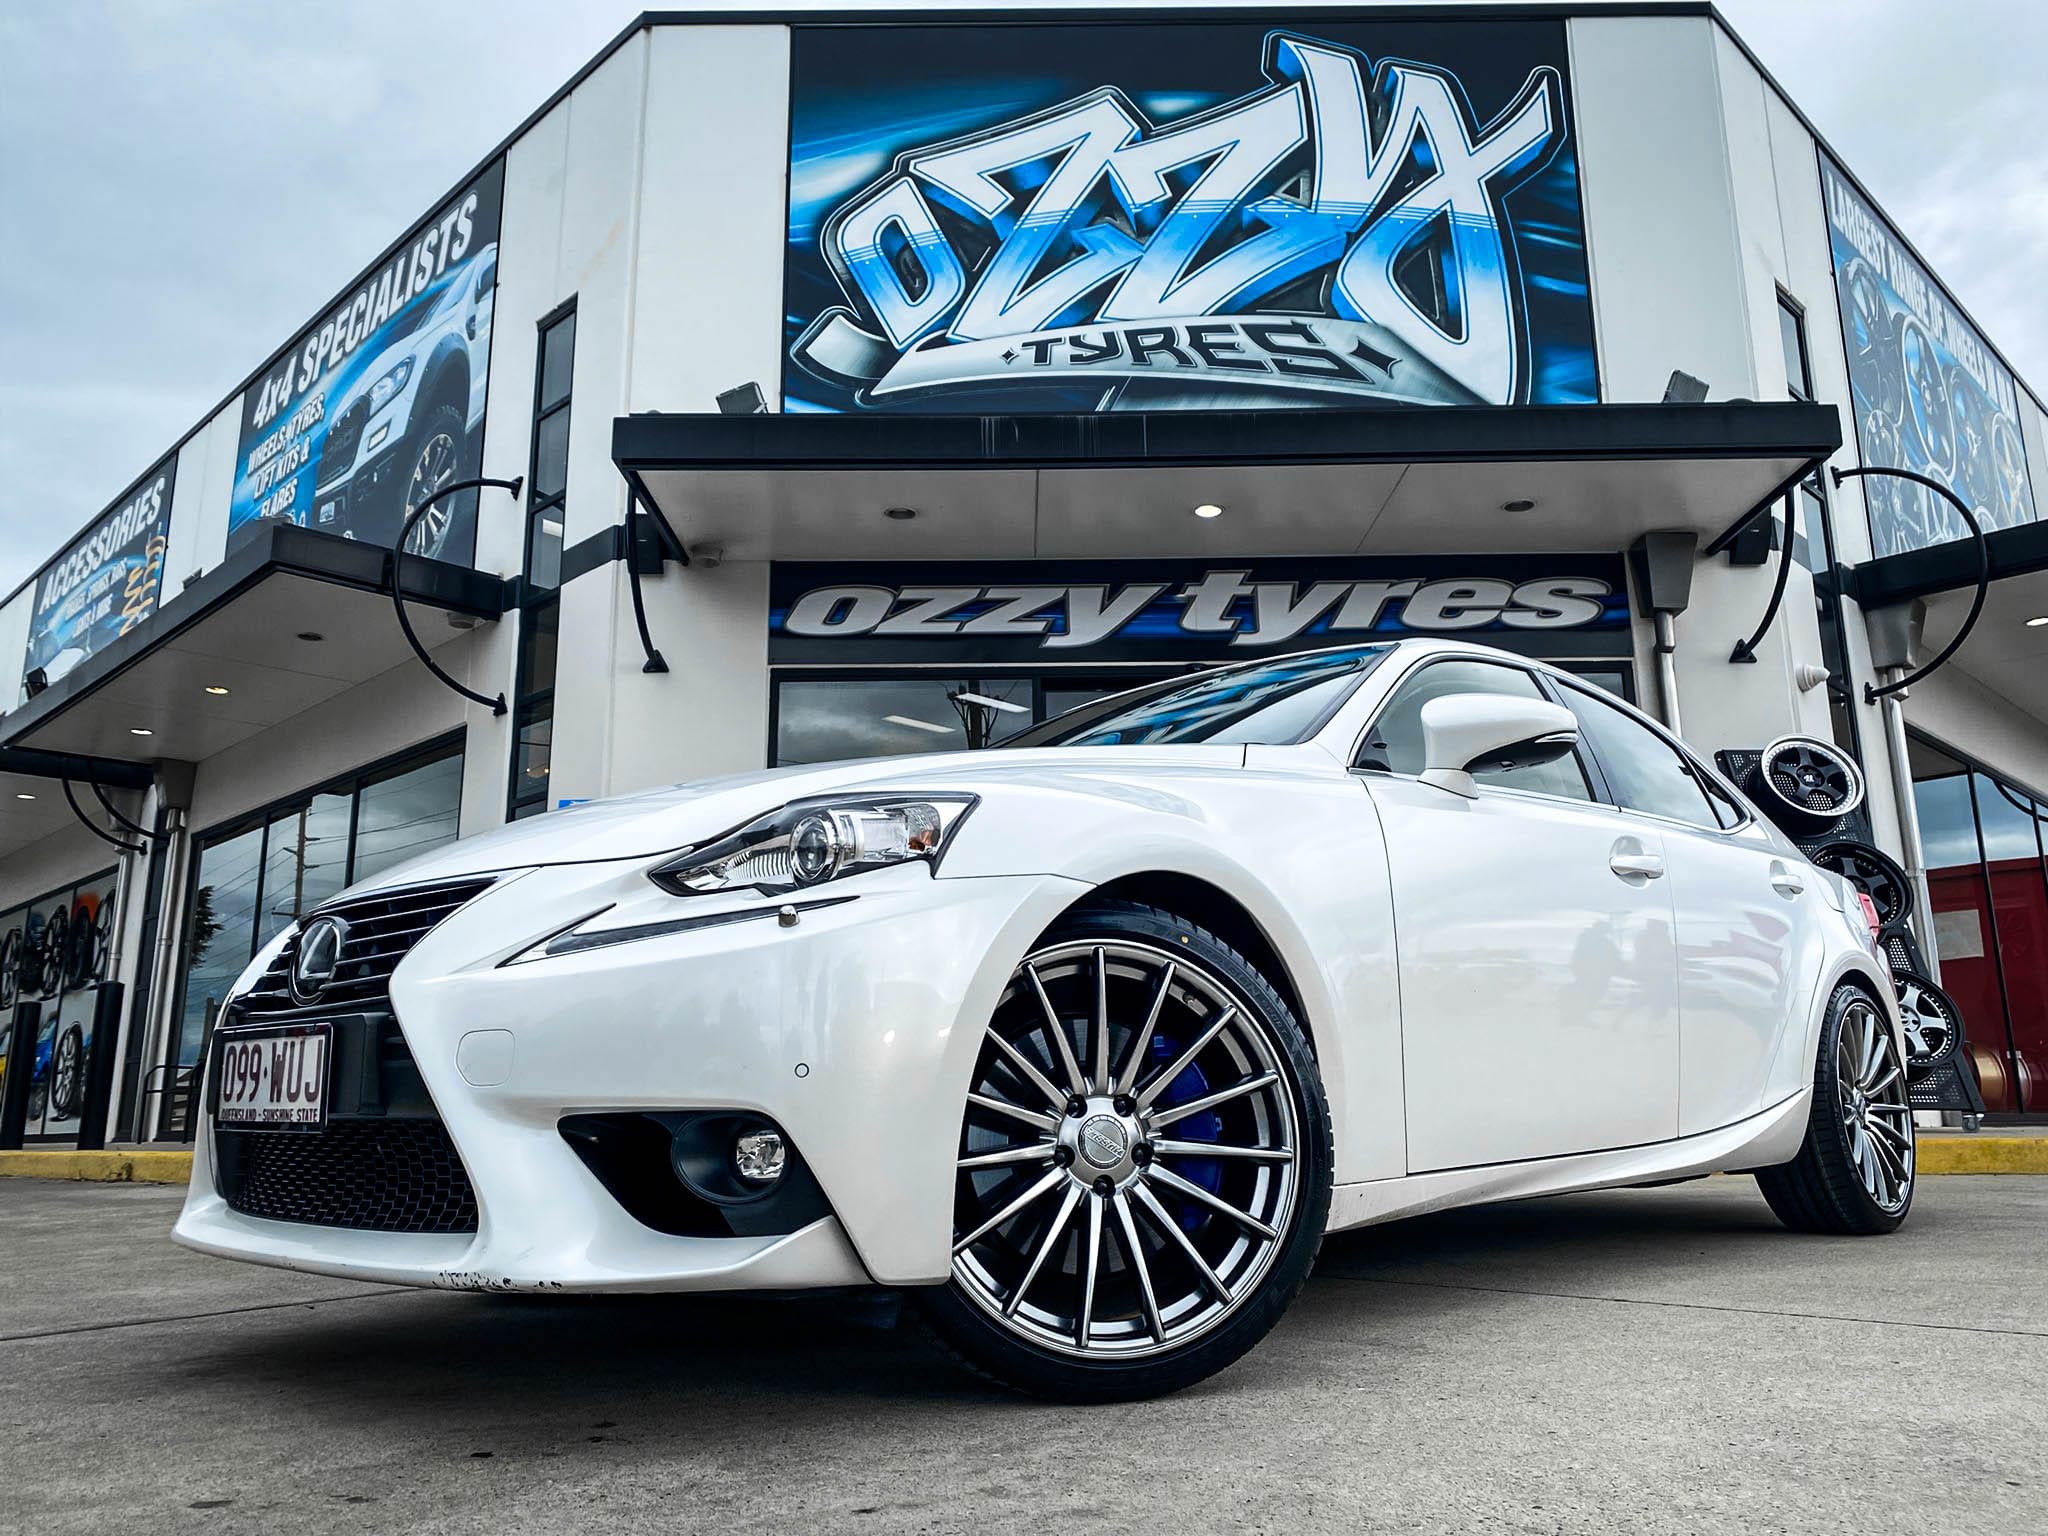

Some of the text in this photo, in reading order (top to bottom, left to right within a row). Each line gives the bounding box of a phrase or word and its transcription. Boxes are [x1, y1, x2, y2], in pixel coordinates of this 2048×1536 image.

[298, 193, 477, 393] SPECIALISTS
[1827, 169, 1888, 281] LARGEST
[1887, 237, 1930, 328] RANGE
[1928, 286, 1944, 344] OF
[1943, 302, 1987, 393] WHEELS
[1020, 319, 1374, 385] TYRES
[254, 435, 310, 499] LIFT KITS &
[38, 477, 165, 616] ACCESSORIES
[781, 569, 1612, 649] ozzy tyres
[297, 1108, 318, 1121] STATE
